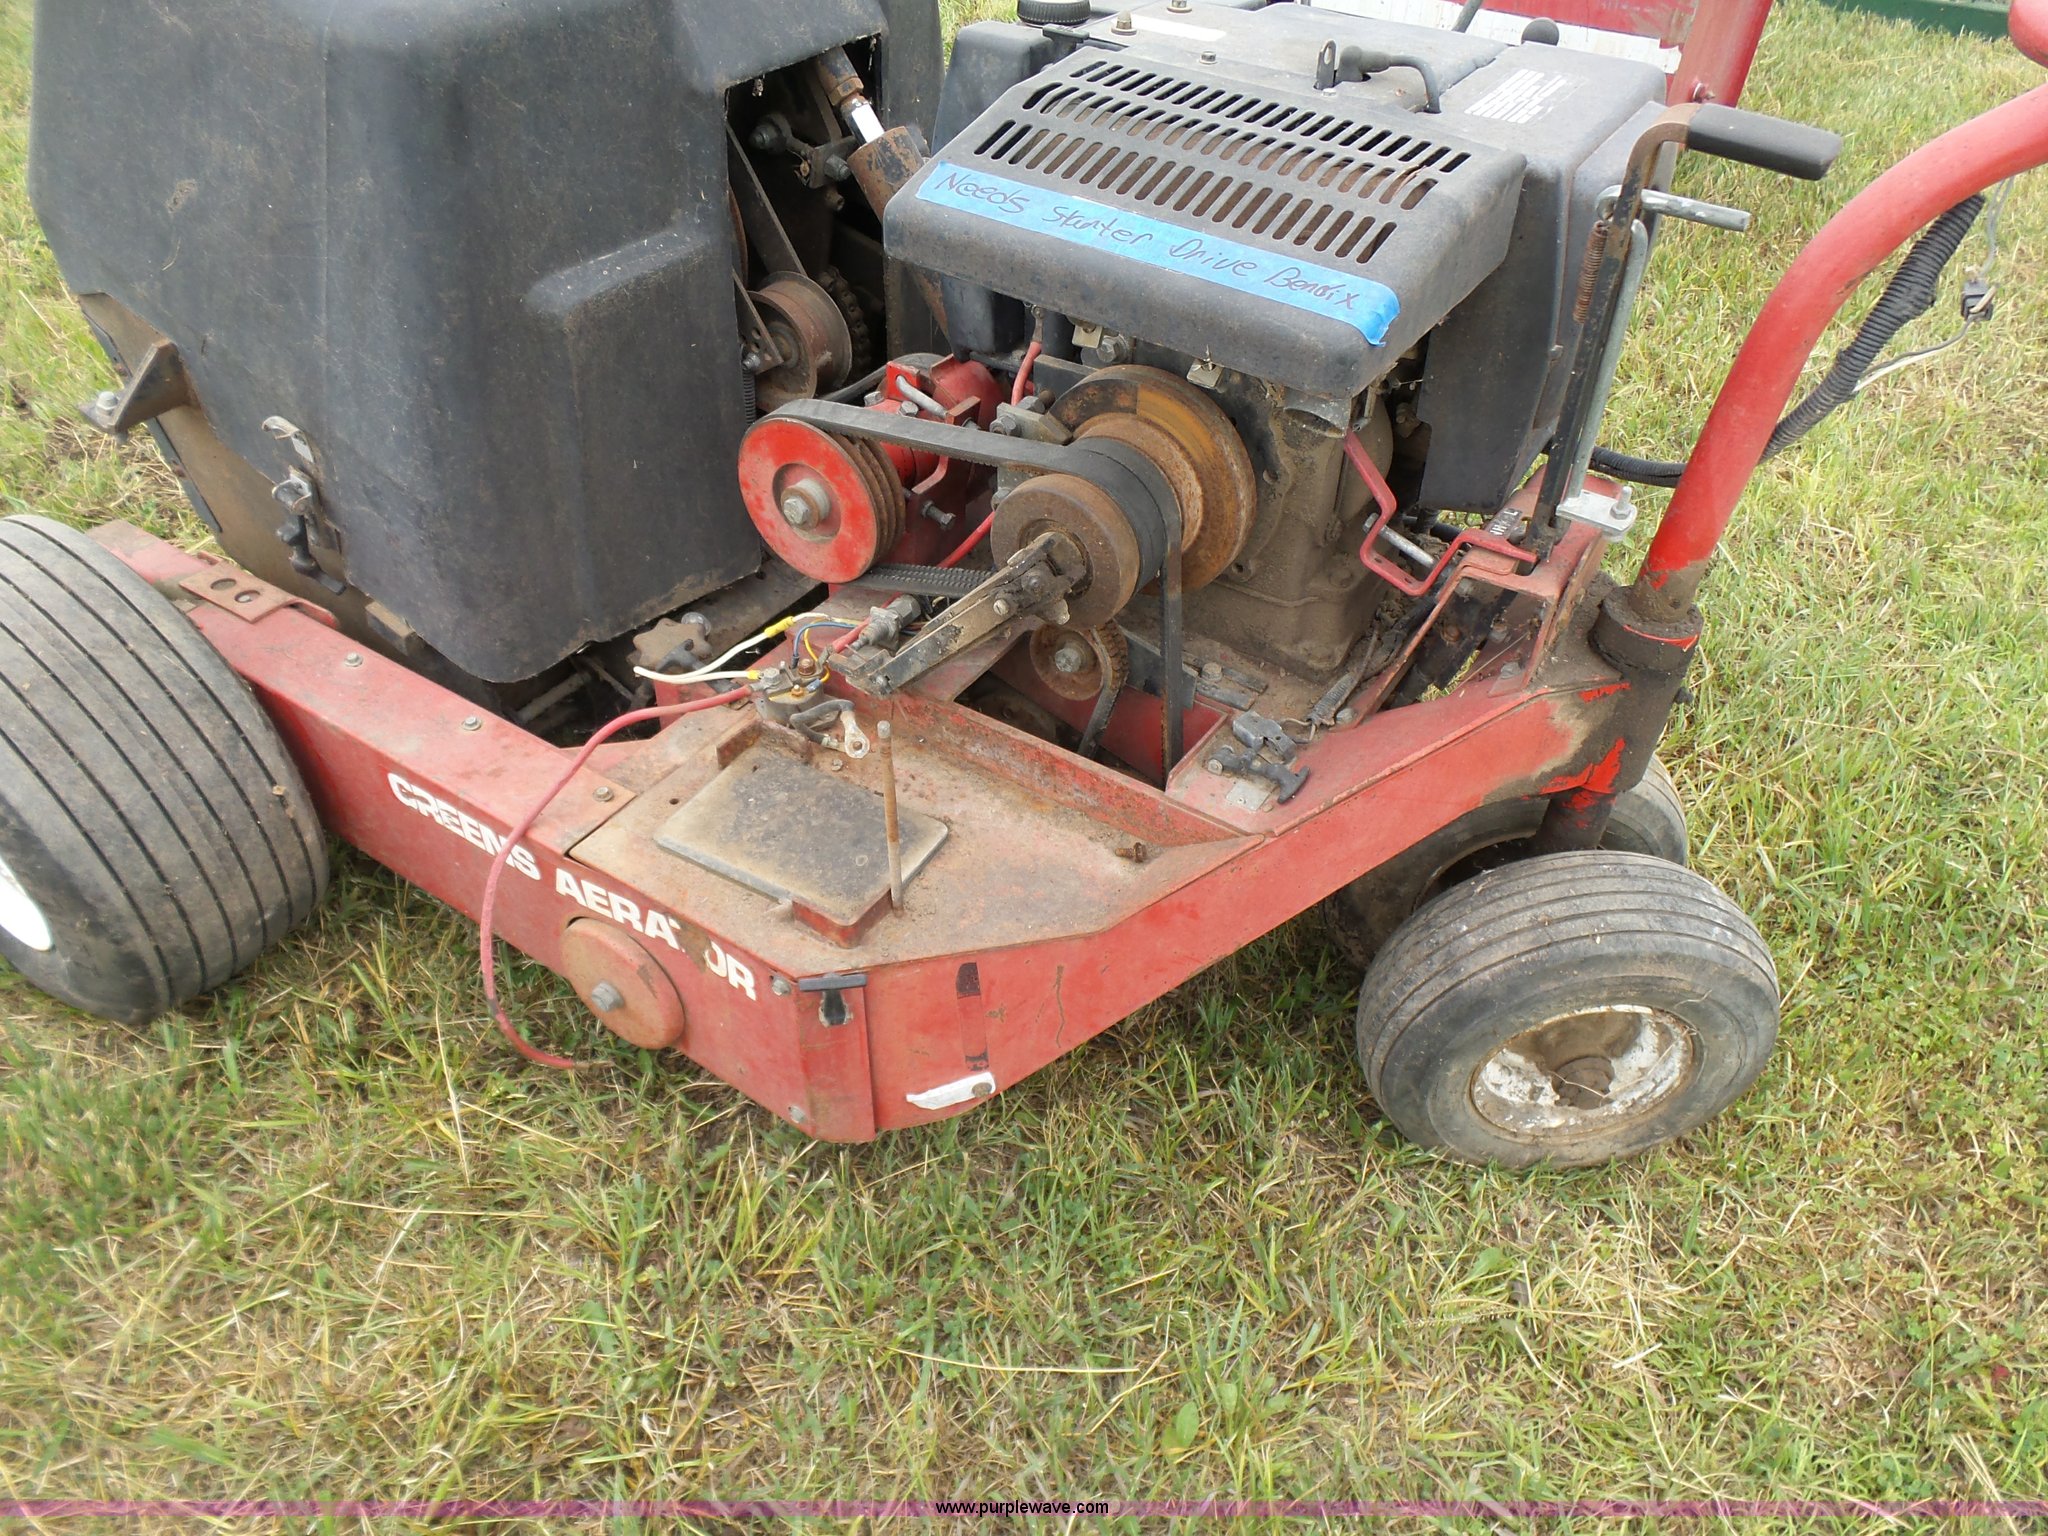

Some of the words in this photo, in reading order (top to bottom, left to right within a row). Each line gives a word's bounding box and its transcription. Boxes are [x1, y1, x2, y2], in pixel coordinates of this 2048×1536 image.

[934, 171, 1030, 214] Needs
[1169, 238, 1258, 277] Drive
[1263, 266, 1360, 310] Bendix
[387, 772, 541, 881] GREENS
[555, 867, 757, 1002] AERAOR
